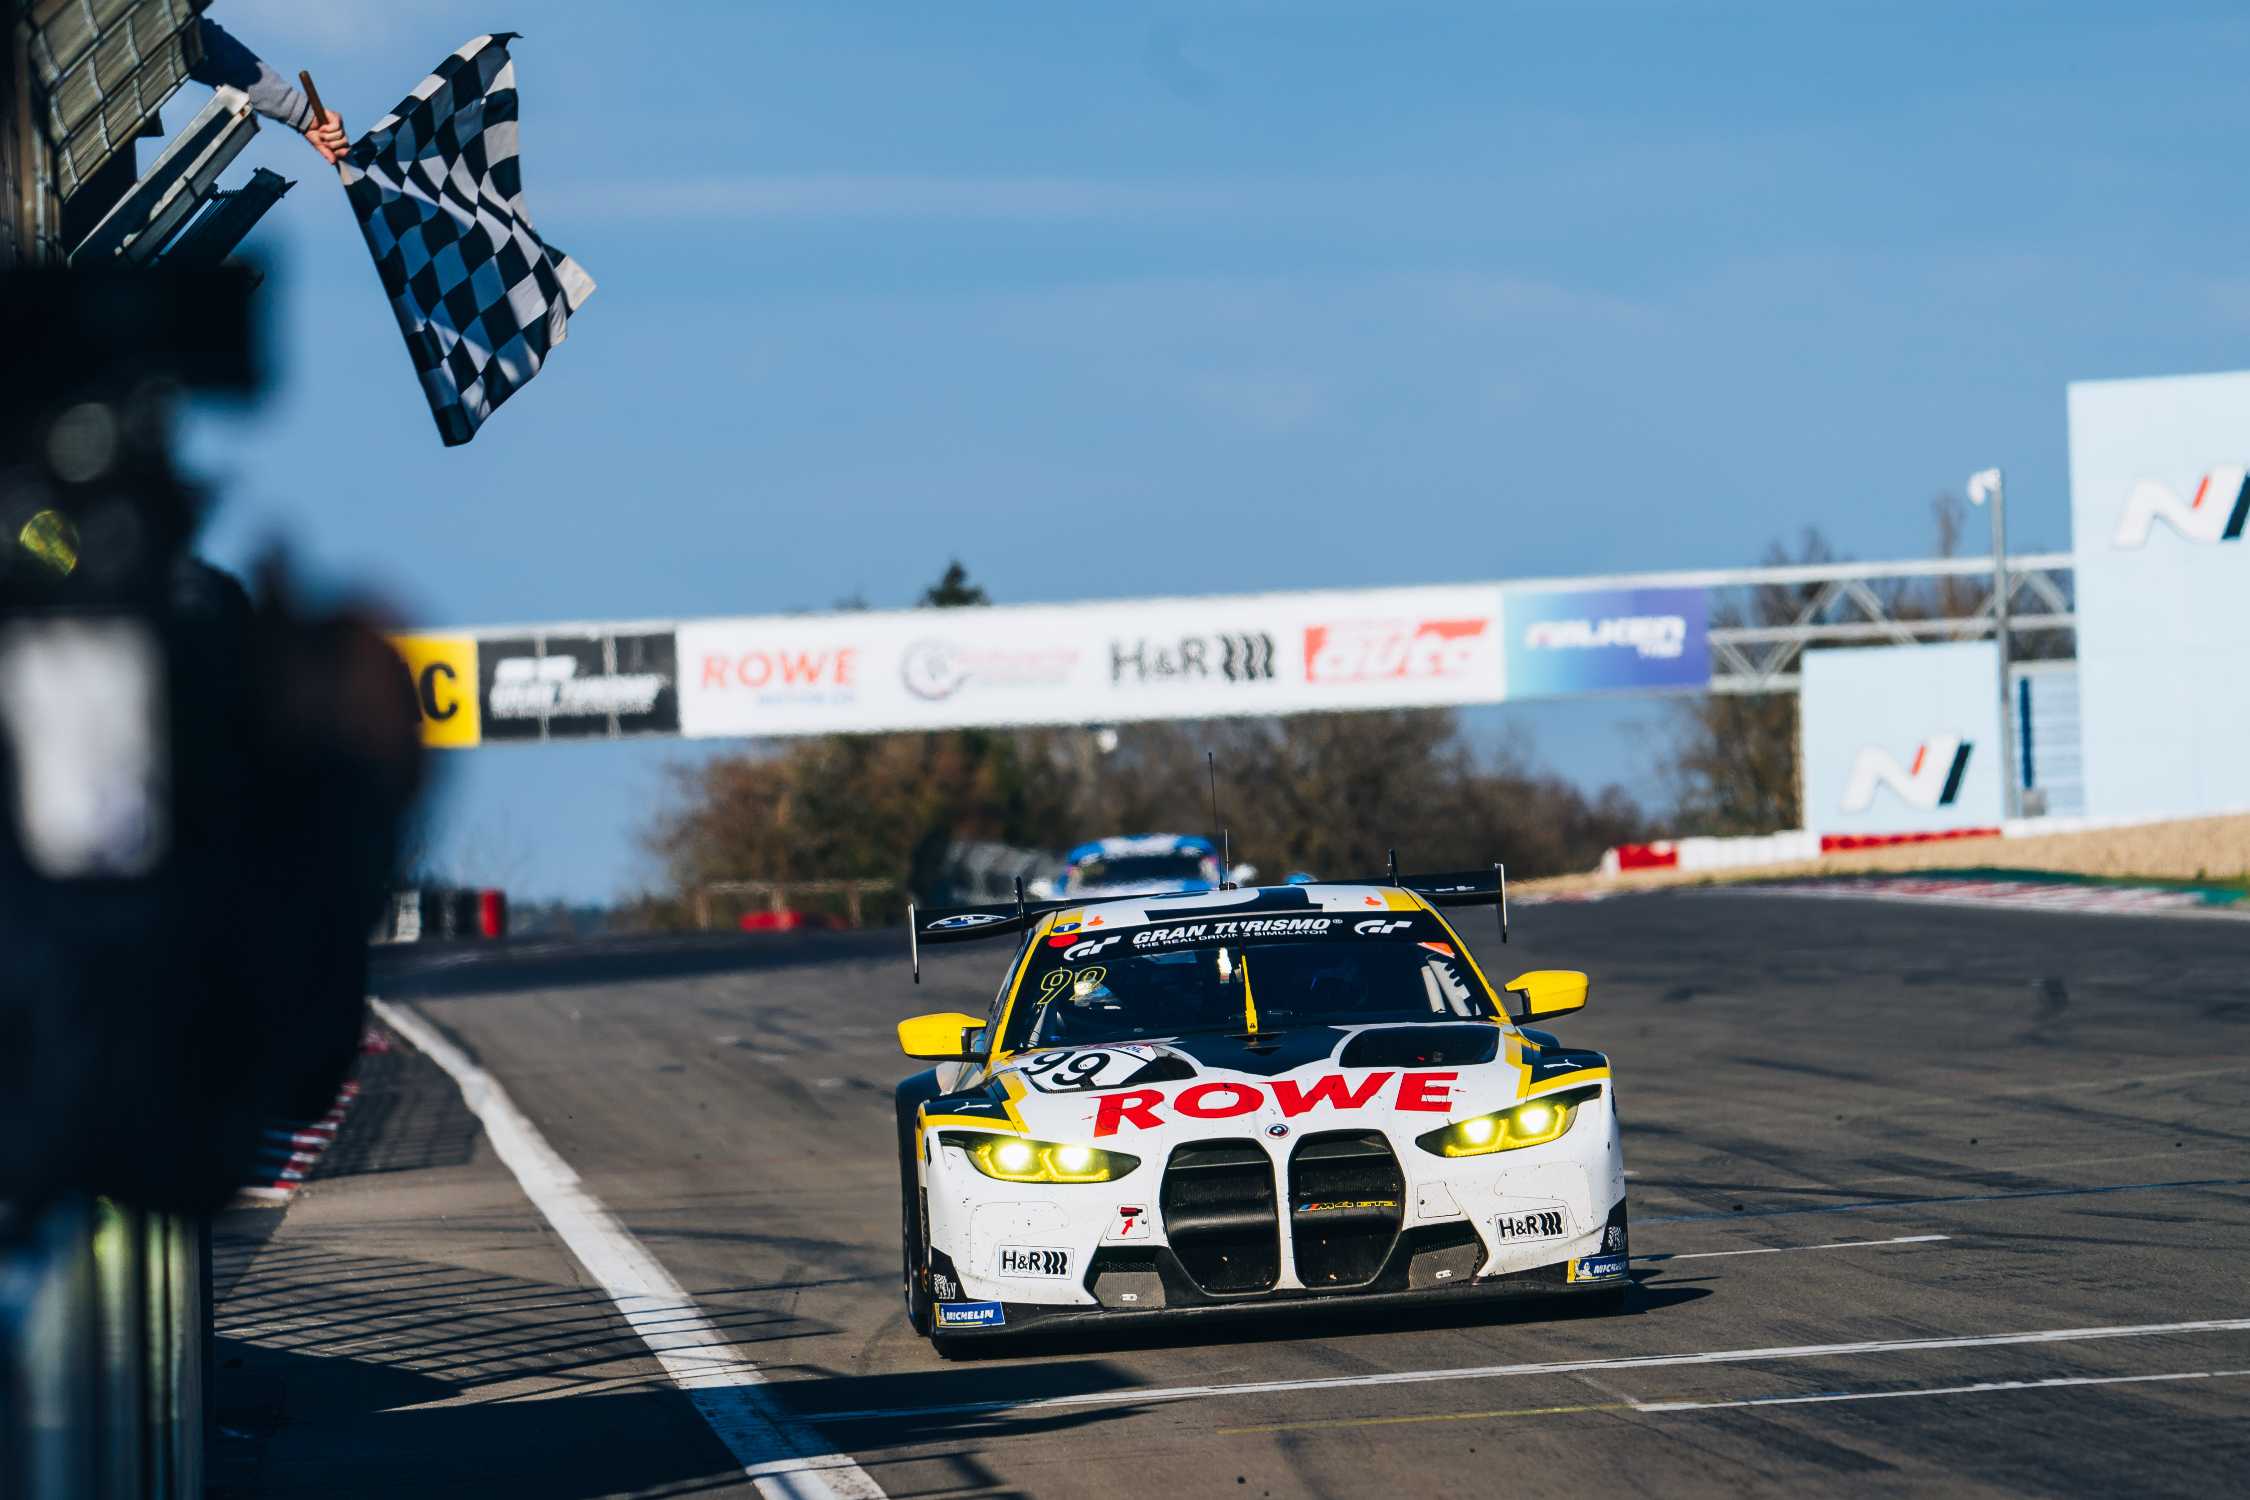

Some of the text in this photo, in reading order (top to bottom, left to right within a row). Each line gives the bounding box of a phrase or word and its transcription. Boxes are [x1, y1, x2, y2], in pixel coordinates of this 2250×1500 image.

[702, 647, 859, 689] ROWE
[1132, 924, 1208, 944] GRAN
[1134, 942, 1159, 950] THE
[1162, 938, 1196, 947] REAL
[1253, 929, 1329, 938] SIMULATOR
[1020, 1051, 1111, 1087] 99
[1088, 1072, 1459, 1138] ROWE
[1499, 1215, 1539, 1238] H&R
[1002, 1250, 1042, 1271] H&R
[946, 1308, 995, 1322] MICHELIN
